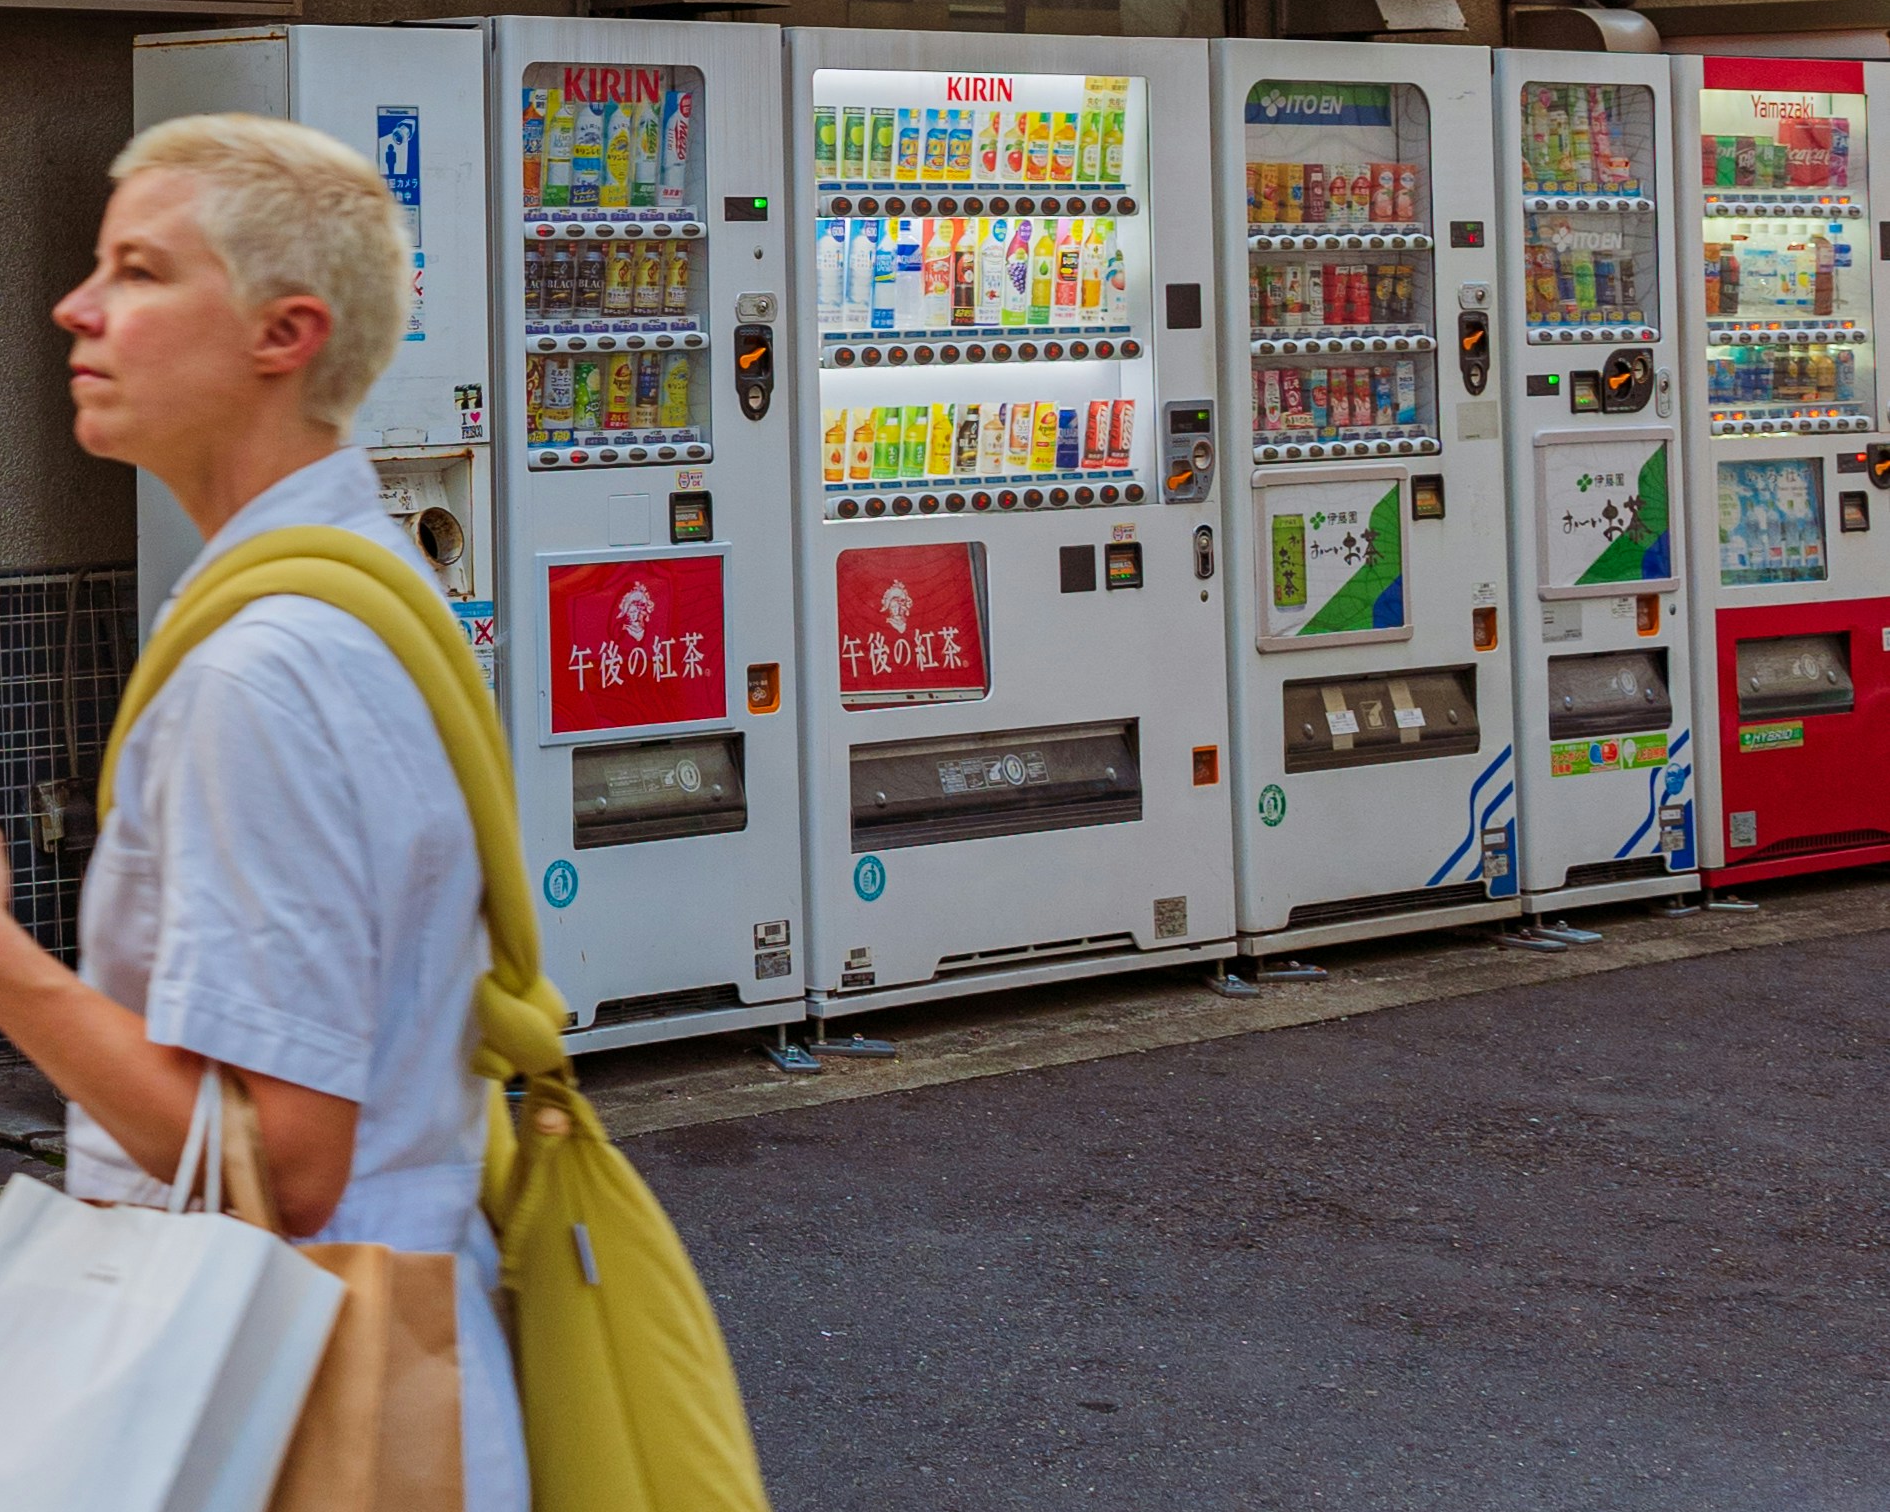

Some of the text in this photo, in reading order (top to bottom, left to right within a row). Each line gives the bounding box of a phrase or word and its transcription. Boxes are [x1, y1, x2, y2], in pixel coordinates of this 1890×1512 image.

[563, 67, 660, 103] KIRIN
[947, 76, 1013, 102] KIRIN
[1285, 95, 1343, 114] ITO EN
[1751, 95, 1814, 118] Yamazaki
[1572, 232, 1622, 250] ITO EN
[569, 632, 705, 691] 午後の紅茶
[842, 627, 962, 677] 午後の紅茶
